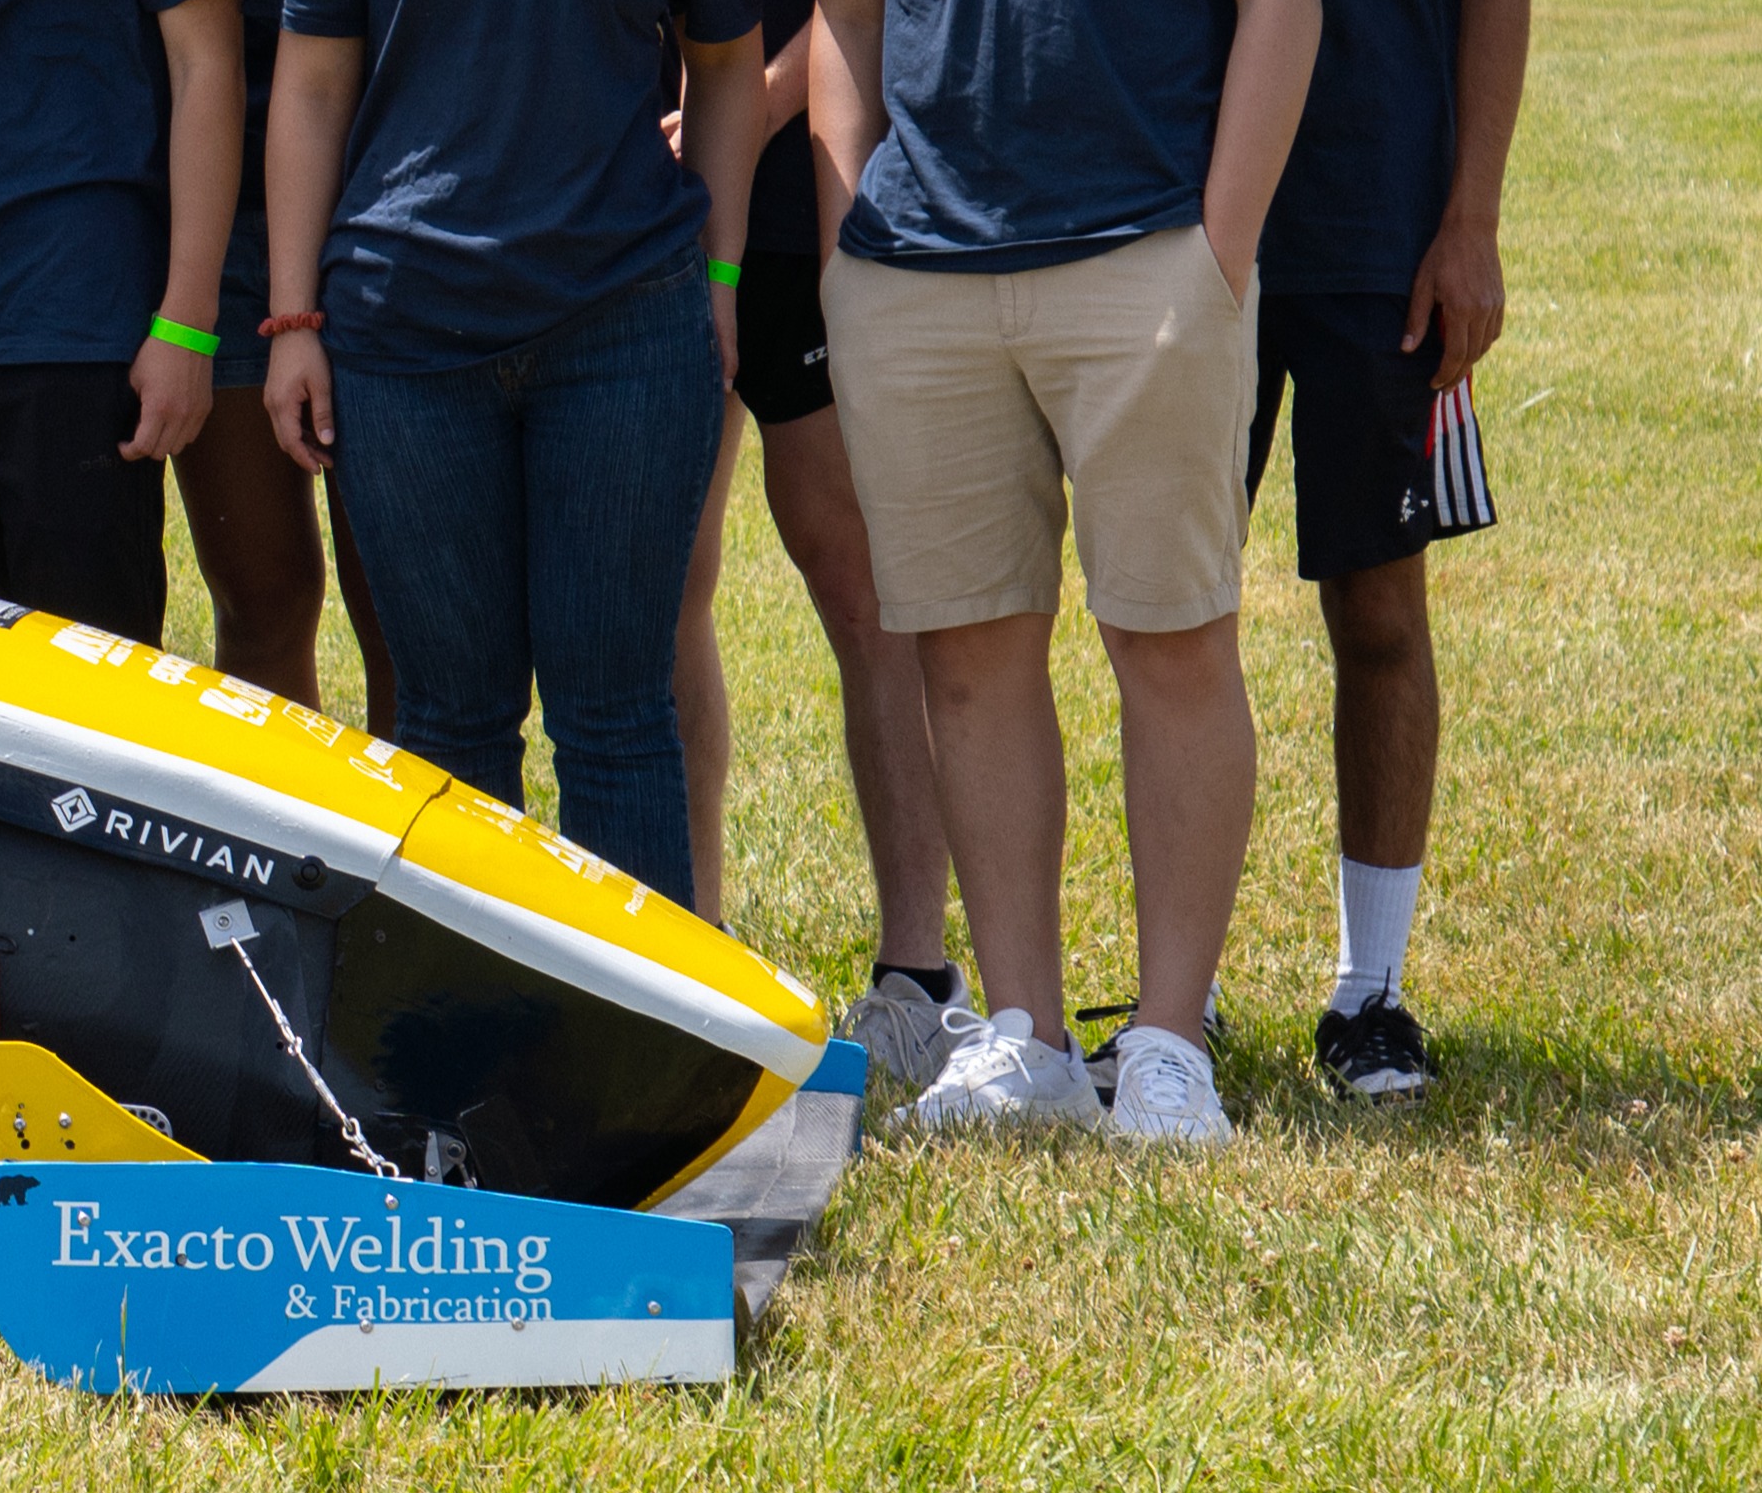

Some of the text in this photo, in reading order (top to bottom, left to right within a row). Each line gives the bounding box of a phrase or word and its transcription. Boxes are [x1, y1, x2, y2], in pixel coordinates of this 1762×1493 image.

[104, 809, 275, 886] RIVIAN
[51, 1200, 275, 1271] Exacto
[279, 1215, 553, 1294] Welding
[284, 1283, 555, 1322] & Fabrication
